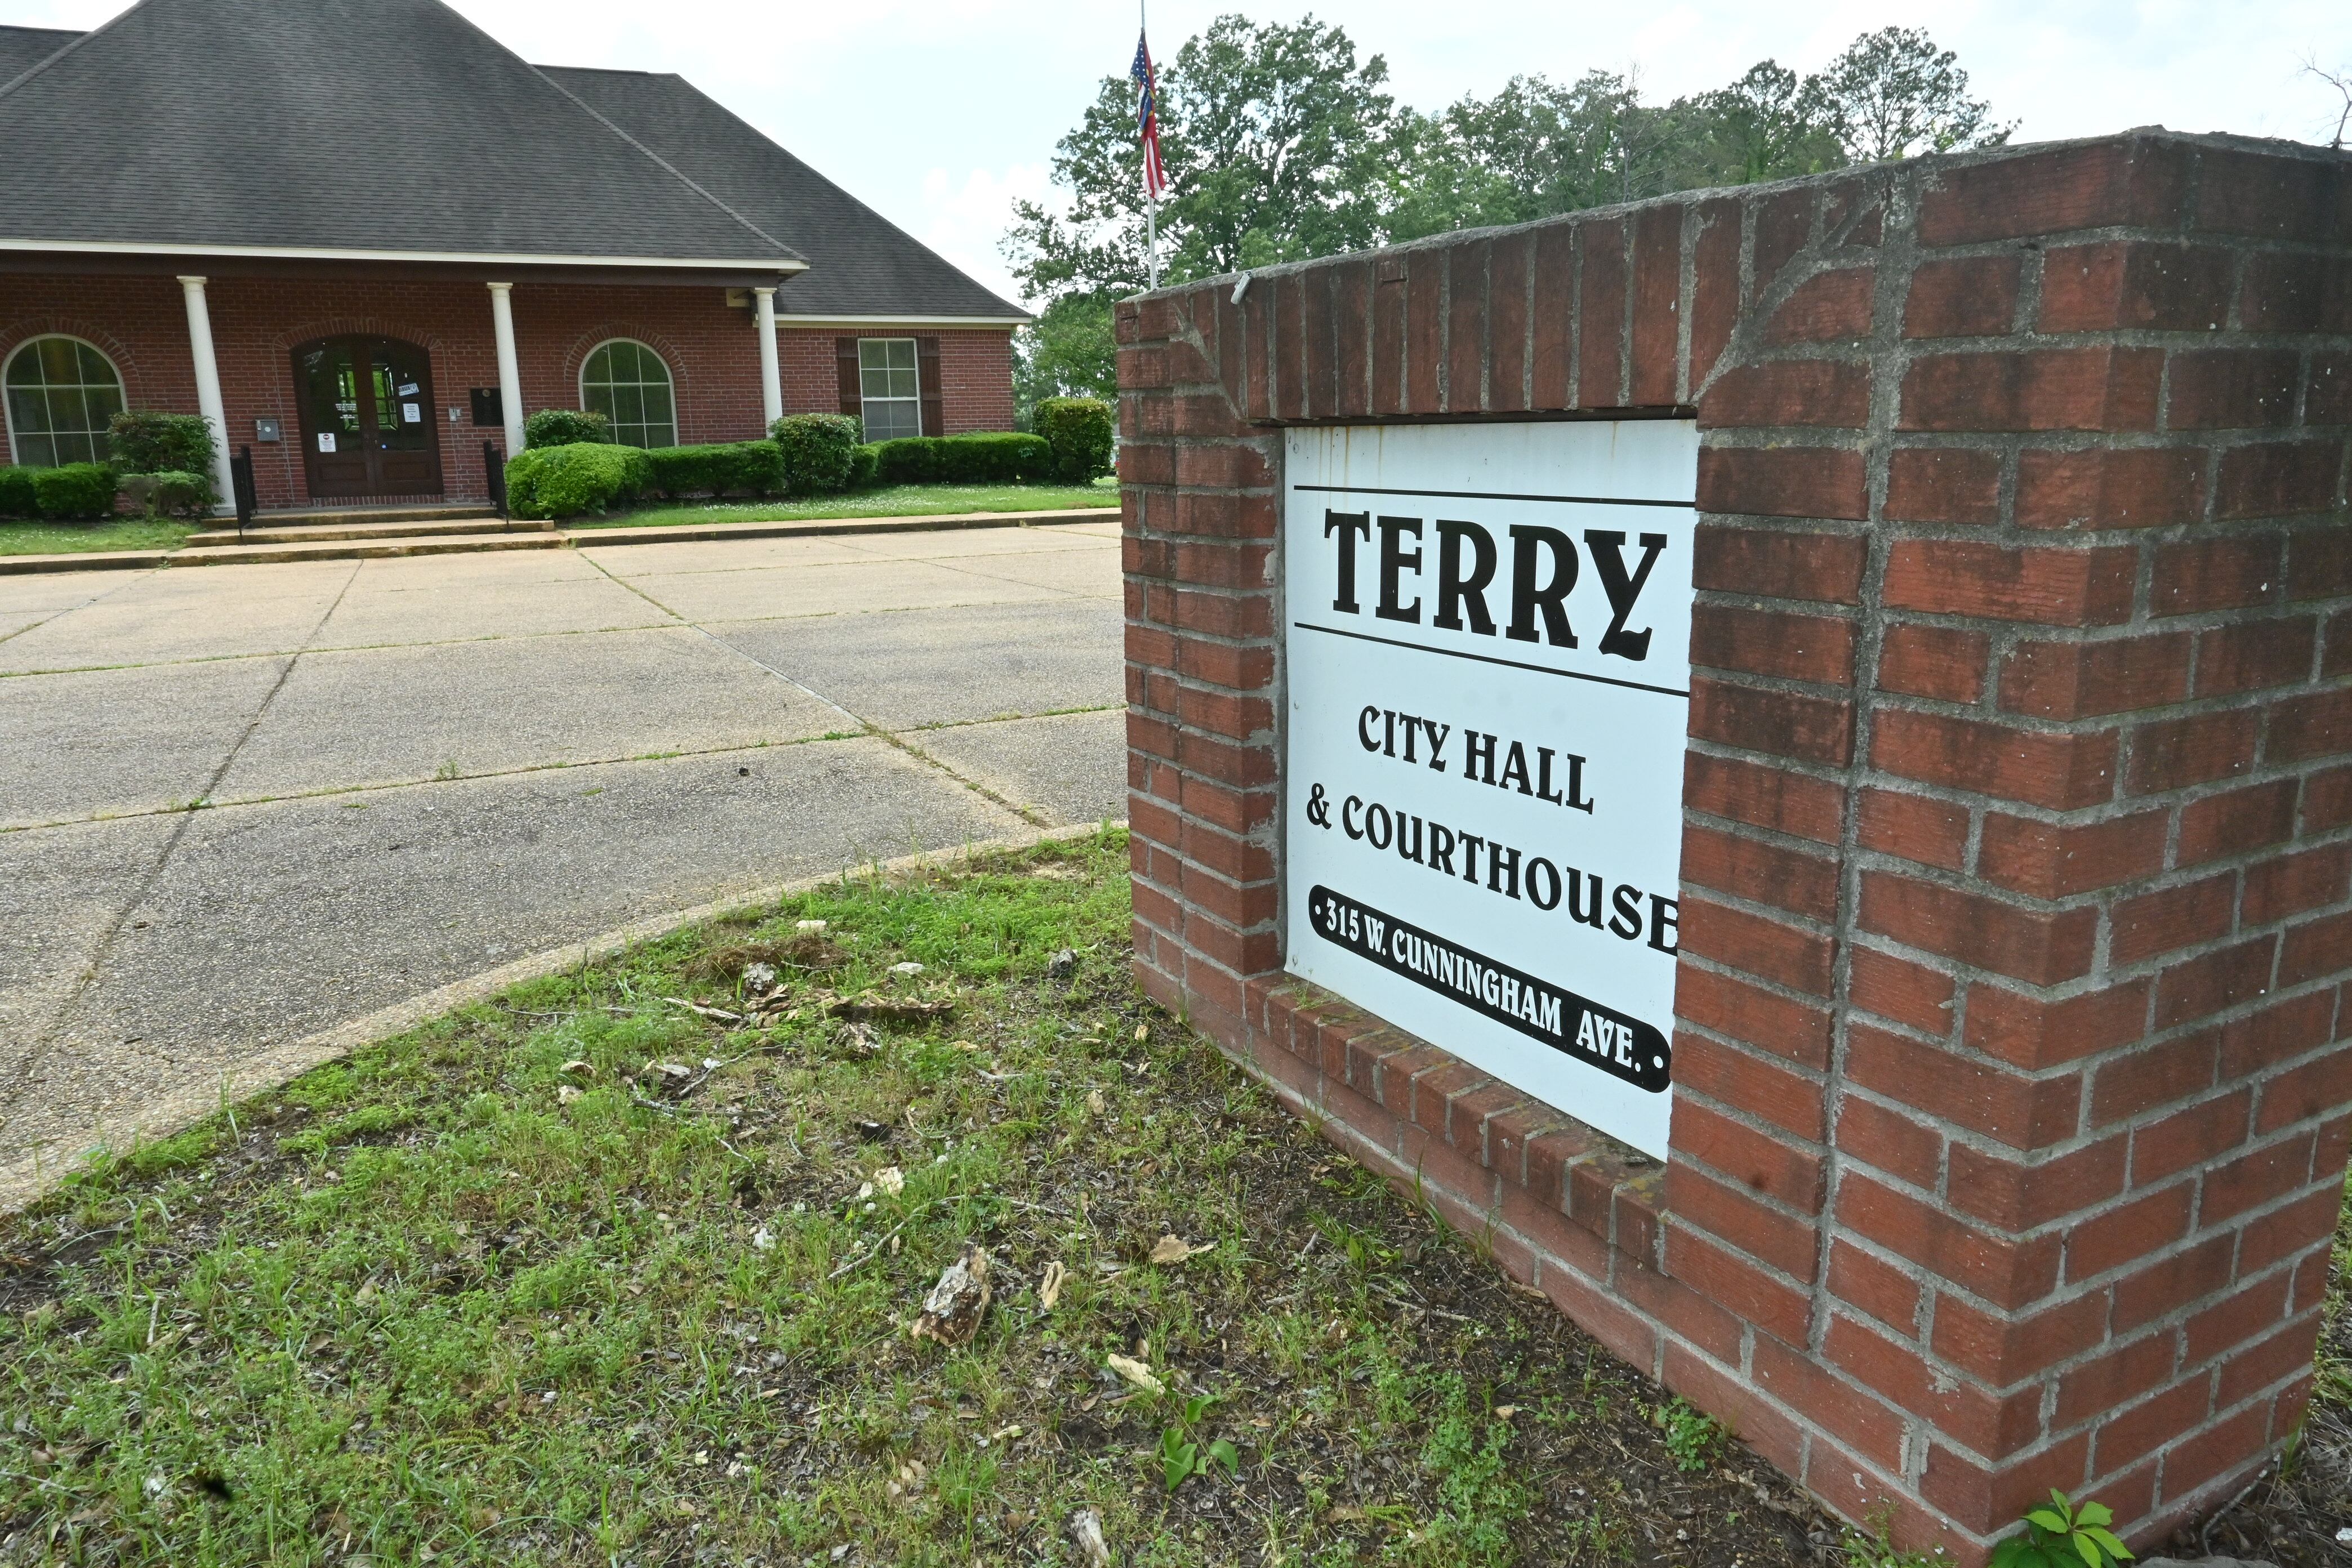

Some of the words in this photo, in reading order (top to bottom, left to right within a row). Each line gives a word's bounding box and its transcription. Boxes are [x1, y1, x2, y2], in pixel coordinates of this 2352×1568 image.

[1324, 508, 1668, 661] TERRY
[1358, 705, 1450, 772] CITY
[1464, 729, 1594, 815] HALL
[1306, 783, 1332, 830] &
[1342, 795, 1679, 957] COURTHOUSE
[1326, 897, 1359, 942] 315
[1364, 914, 1387, 956] W.
[1392, 928, 1562, 1037] CUNNINGHAM
[1576, 1009, 1642, 1073] AVE.
